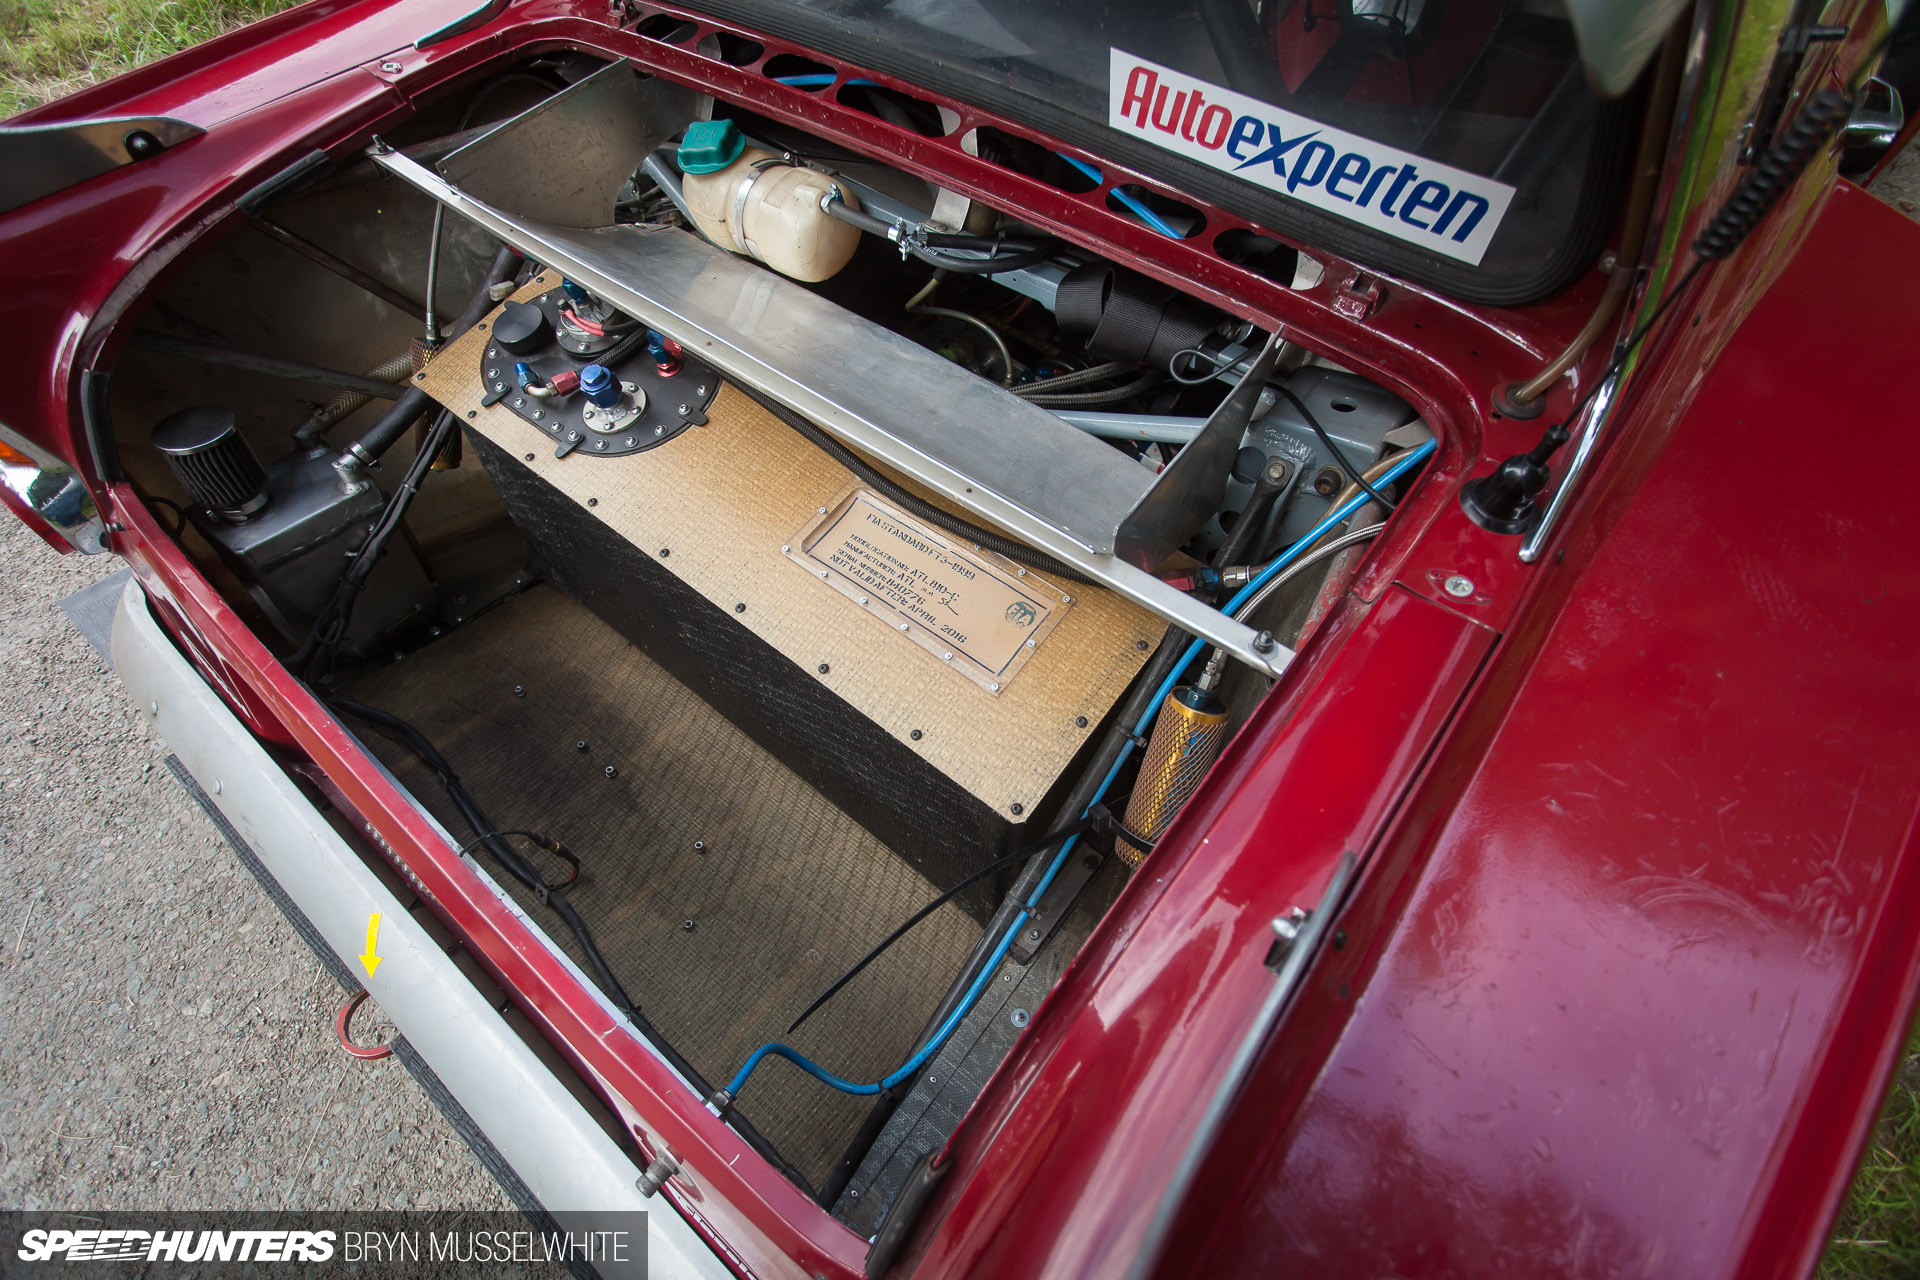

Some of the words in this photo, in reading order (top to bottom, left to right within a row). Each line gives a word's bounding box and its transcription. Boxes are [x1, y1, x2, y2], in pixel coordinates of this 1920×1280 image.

[1120, 65, 1490, 243] Autoexperten
[836, 548, 858, 564] SERIAL
[858, 562, 887, 582] NUMBER:
[886, 578, 926, 605] 840776
[843, 541, 897, 576] MANUFACTURER:
[896, 572, 915, 588] ATL
[850, 533, 899, 565] HOMOLOGATION
[909, 568, 928, 584] ATL
[866, 513, 882, 526] FIA
[880, 521, 930, 553] STANDARD
[928, 549, 976, 580] FT3-1999
[829, 554, 850, 567] NOT
[849, 565, 876, 584] VALID
[872, 582, 909, 606] AFTER:
[907, 604, 937, 626] APRIL
[940, 624, 967, 643] 2016
